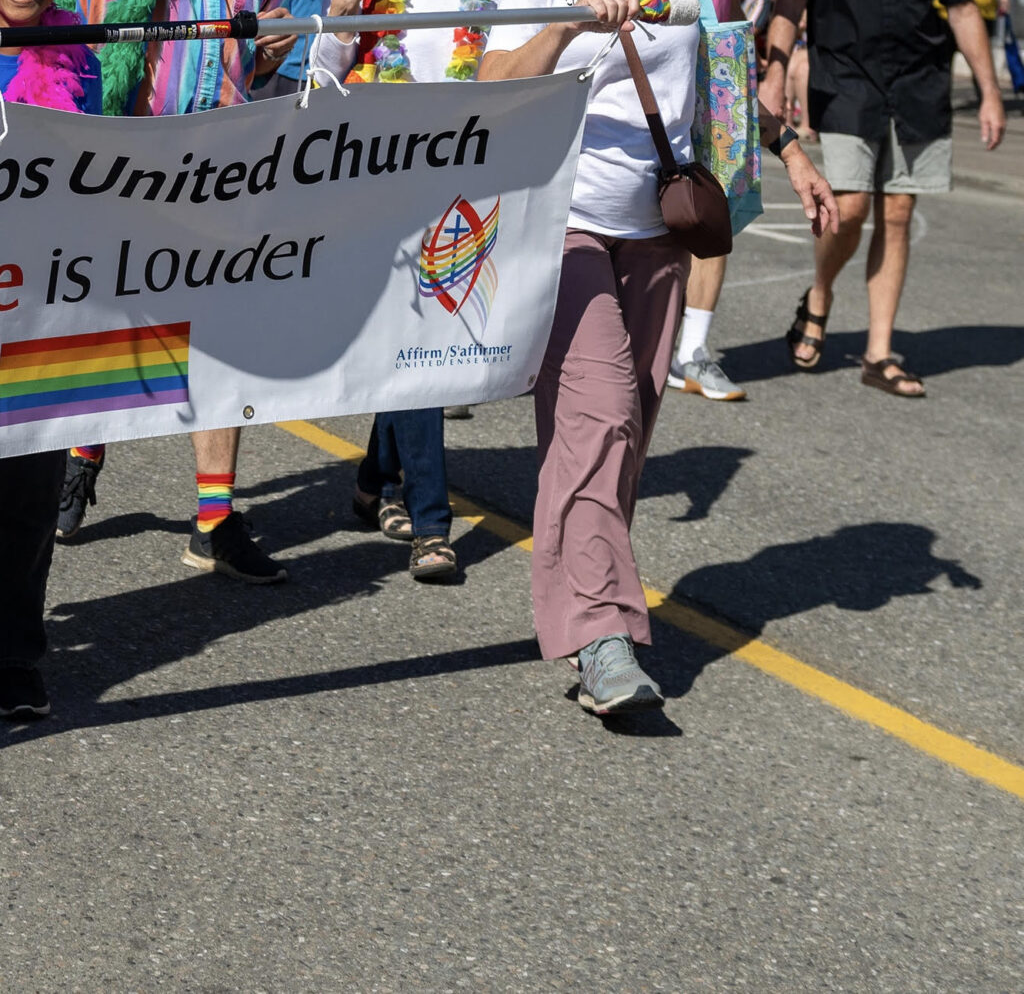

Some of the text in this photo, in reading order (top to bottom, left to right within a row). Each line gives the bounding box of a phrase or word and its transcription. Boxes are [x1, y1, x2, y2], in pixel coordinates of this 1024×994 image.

[68, 134, 285, 203] United
[292, 114, 490, 184] Church
[45, 247, 92, 304] is
[115, 233, 325, 297] Louder
